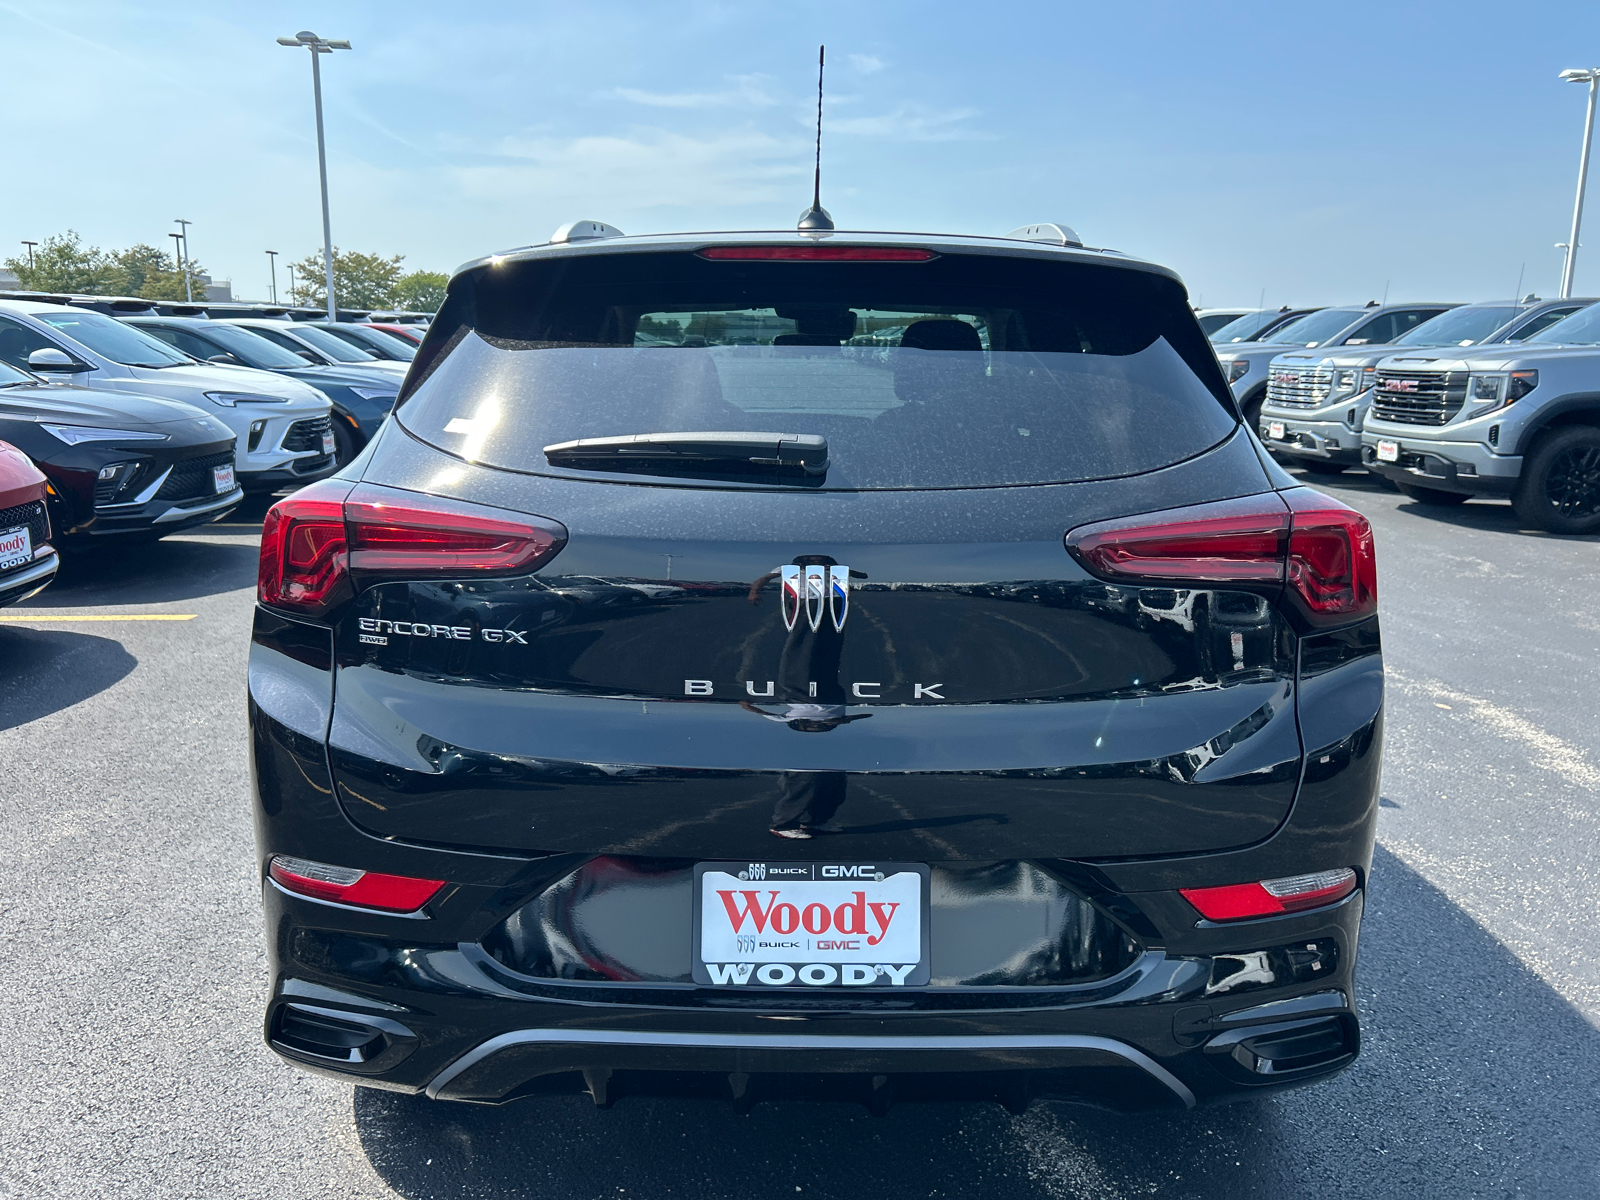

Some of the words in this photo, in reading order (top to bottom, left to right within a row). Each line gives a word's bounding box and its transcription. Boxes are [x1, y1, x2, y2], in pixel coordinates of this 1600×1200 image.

[1385, 379, 1419, 392] GMC
[0, 535, 25, 553] oody
[0, 554, 32, 569] OODY
[358, 617, 472, 641] ENCORE
[481, 628, 529, 645] GX
[684, 679, 946, 699] BUICK
[769, 867, 808, 875] BUICK
[821, 865, 875, 878] GMC
[716, 890, 900, 946] Woody
[816, 940, 860, 950] GMC
[705, 963, 917, 985] WOODY
